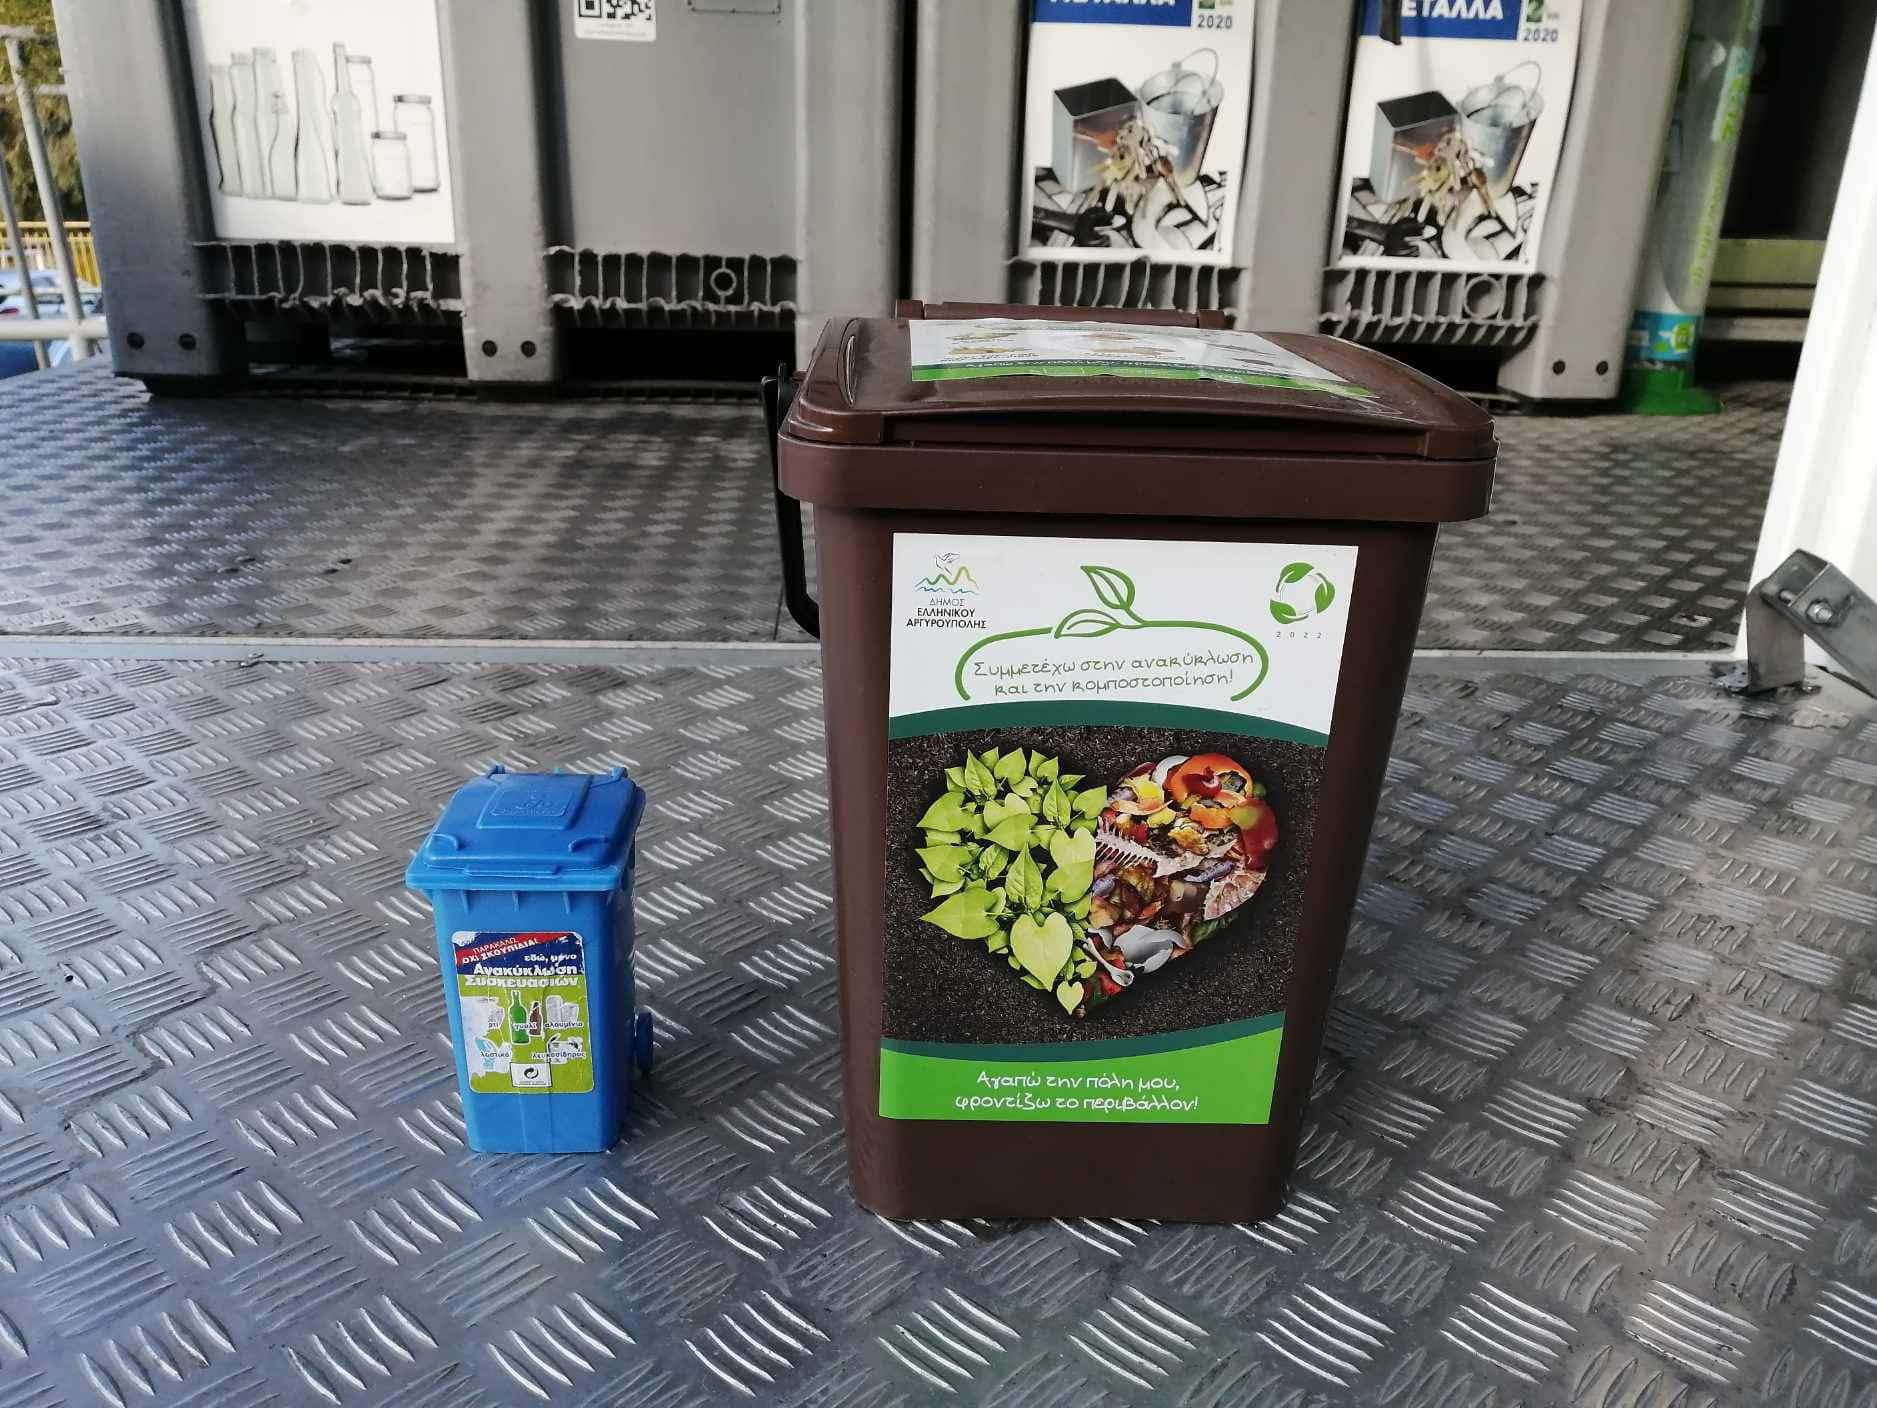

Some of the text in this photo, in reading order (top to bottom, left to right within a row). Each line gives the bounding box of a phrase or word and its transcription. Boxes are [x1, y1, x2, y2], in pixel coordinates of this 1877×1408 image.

[1401, 0, 1504, 19] ΕΤΑΛΛΑ
[1197, 14, 1232, 29] 2020
[1522, 28, 1559, 42] 2020
[929, 598, 965, 607] ΔΗΜΟΣ
[917, 607, 975, 618] ΕΛΛΗΝΙΚΟΥ
[906, 618, 987, 629] ΑΡΓΥΡΟΥΠΟΛΗΣ
[974, 649, 1254, 680] Συμμετέχω στην ανακύκλωση
[994, 669, 1234, 696] και την κομποστοποίηση!
[473, 937, 517, 954] ΠΑΡΑΚΑΛΩ
[465, 975, 578, 988] Συσκευασιών
[977, 1071, 1180, 1092] Αγαπώ την πόλη μου,
[955, 1092, 1199, 1113] φροντίζω το περιβάλλον!
